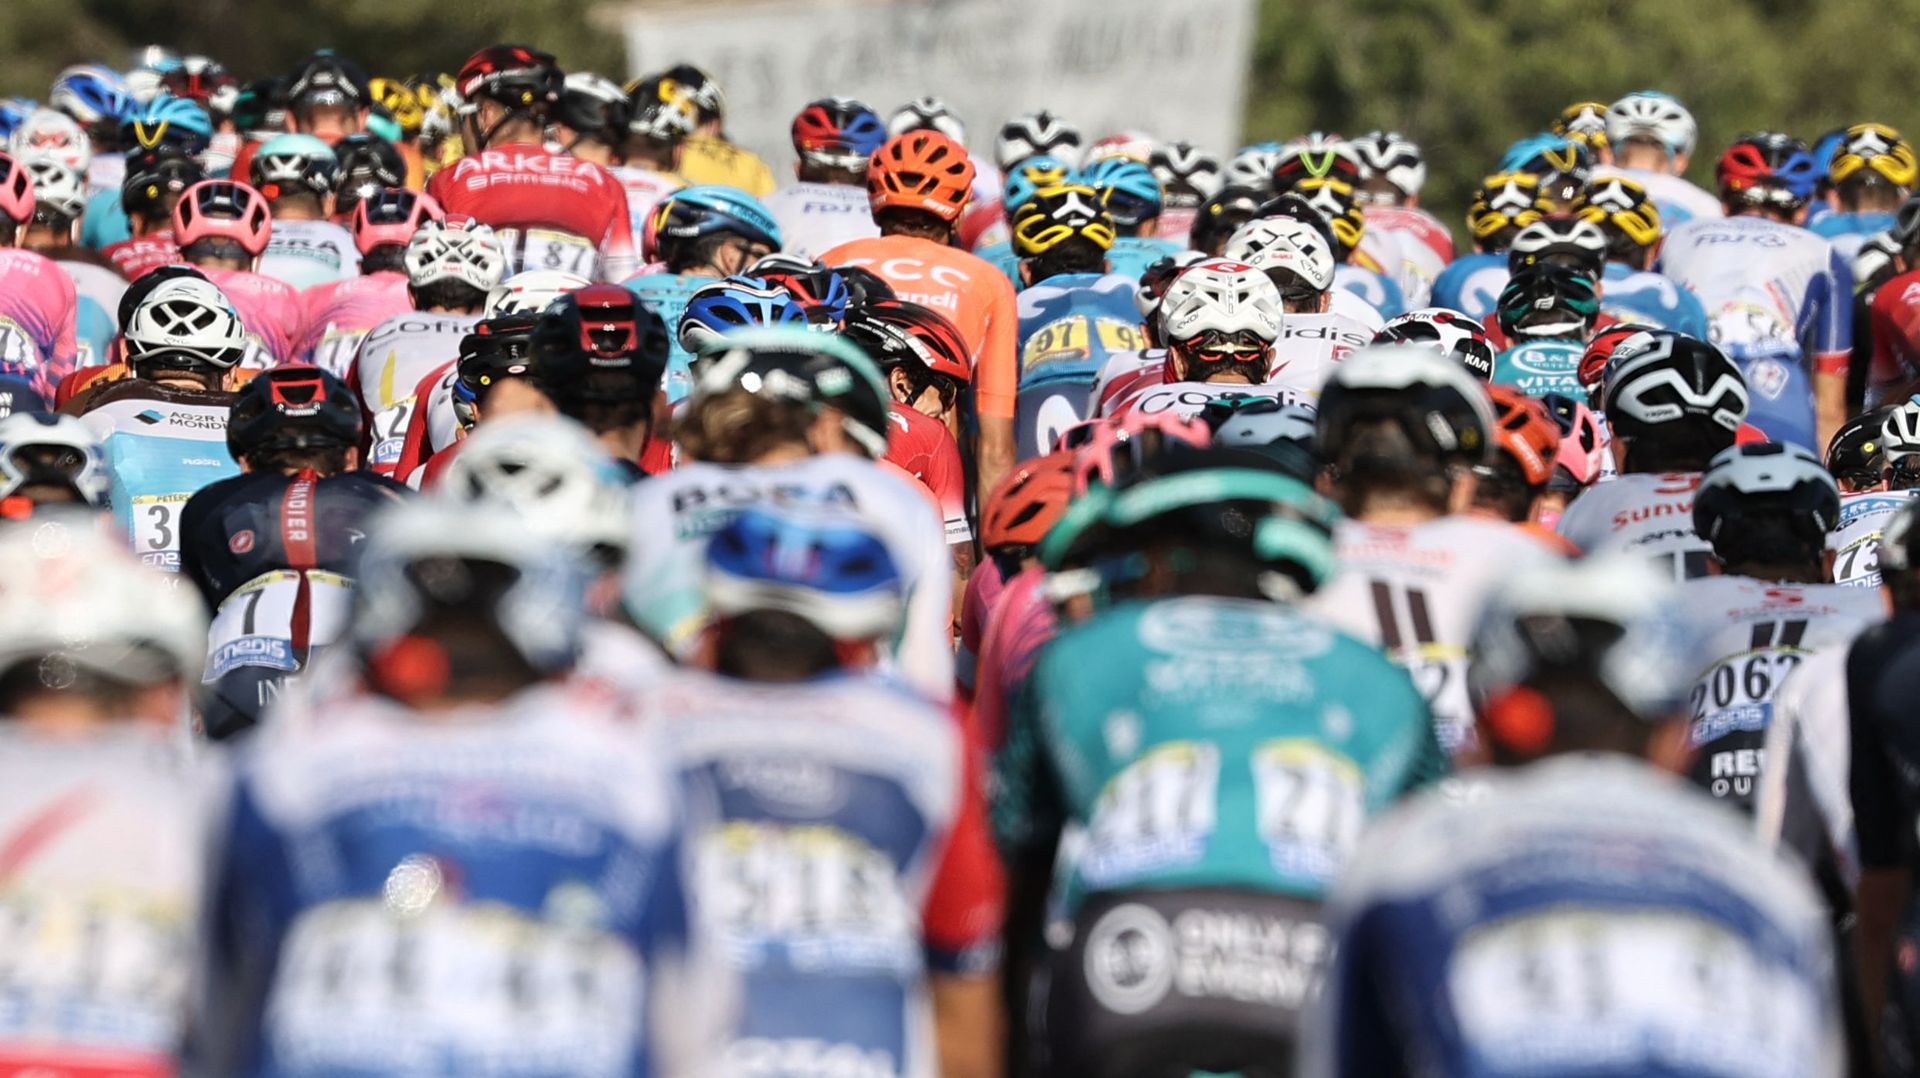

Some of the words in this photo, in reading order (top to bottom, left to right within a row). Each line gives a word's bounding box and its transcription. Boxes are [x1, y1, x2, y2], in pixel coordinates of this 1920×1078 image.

[453, 151, 603, 186] ARKEA
[545, 241, 591, 269] 87
[1035, 321, 1074, 352] 97
[1116, 326, 1143, 351] 9
[1285, 324, 1365, 347] idis
[1465, 353, 1490, 373] KASK
[1517, 376, 1578, 389] VITA
[170, 412, 215, 422] AG2R
[148, 505, 172, 550] 3
[1839, 539, 1880, 580] 73
[240, 587, 265, 635] 7
[1711, 776, 1751, 797] OU
